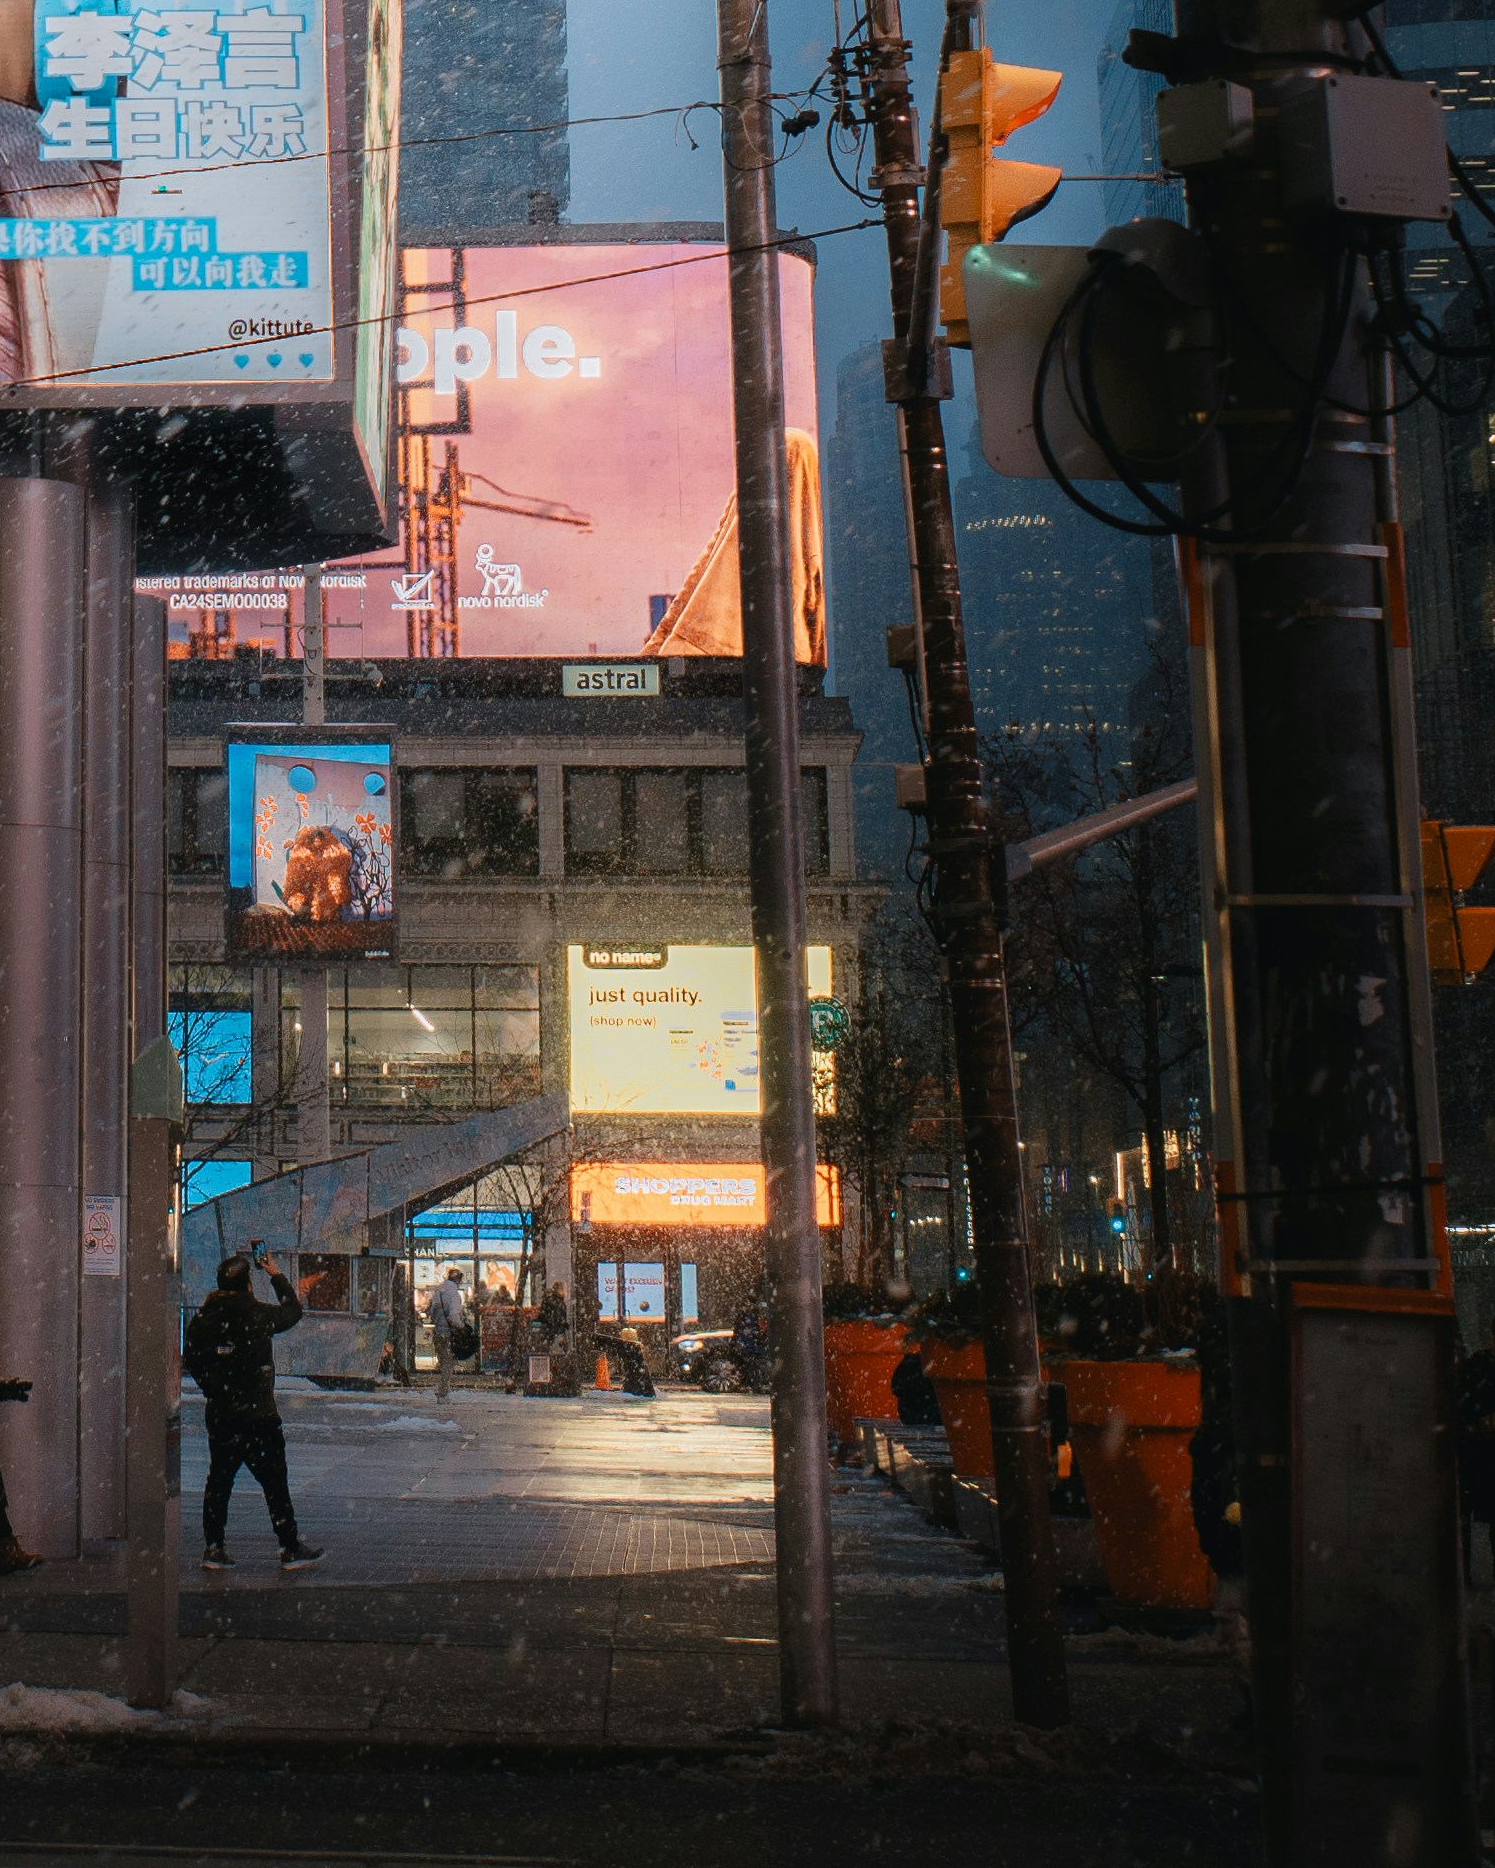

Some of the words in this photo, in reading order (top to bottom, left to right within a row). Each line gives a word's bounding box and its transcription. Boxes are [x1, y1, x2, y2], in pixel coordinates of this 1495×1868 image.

[44, 6, 306, 91] 李泽言
[37, 96, 307, 160] 生日快乐
[138, 256, 298, 288] 可以向我走
[227, 317, 314, 341] @kittute
[183, 573, 259, 589] trademarks
[261, 575, 276, 589] of
[278, 575, 306, 589] Nov
[457, 596, 492, 609] novo
[493, 592, 547, 609] nordisk
[575, 667, 647, 691] astral
[589, 952, 611, 964] no
[589, 986, 626, 1006] just
[632, 987, 704, 1007] quality.
[589, 1015, 624, 1027] (shop
[626, 1015, 658, 1028] now)
[613, 1177, 757, 1195] SHOPPERS
[670, 1195, 712, 1206] DRUG
[713, 1195, 756, 1206] MART
